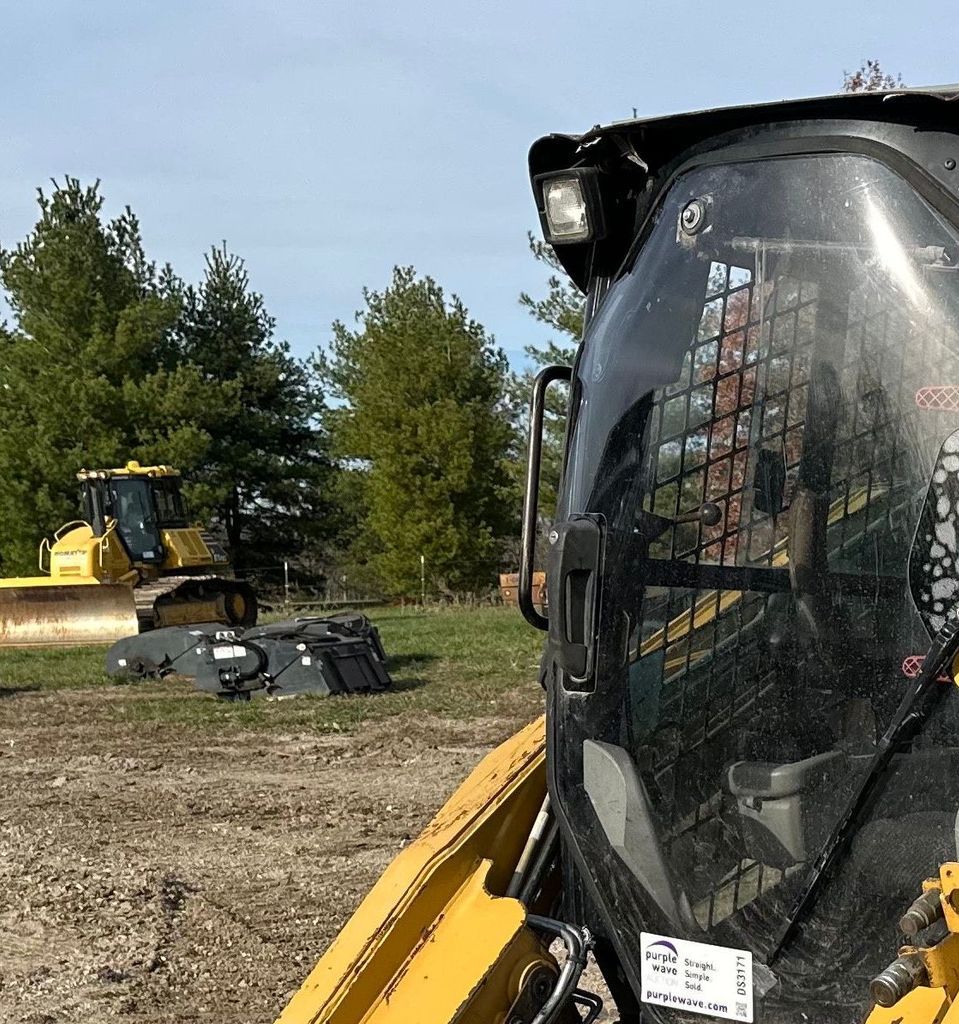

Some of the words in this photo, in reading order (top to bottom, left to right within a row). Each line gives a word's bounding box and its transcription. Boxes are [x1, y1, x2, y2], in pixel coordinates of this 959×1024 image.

[645, 951, 677, 964] purple
[652, 964, 678, 975] wave
[684, 958, 716, 971] Straight.
[684, 969, 712, 983] Simple.
[736, 955, 747, 996] DS3171
[685, 982, 703, 992] Sold.
[646, 990, 728, 1013] purplewave.com
